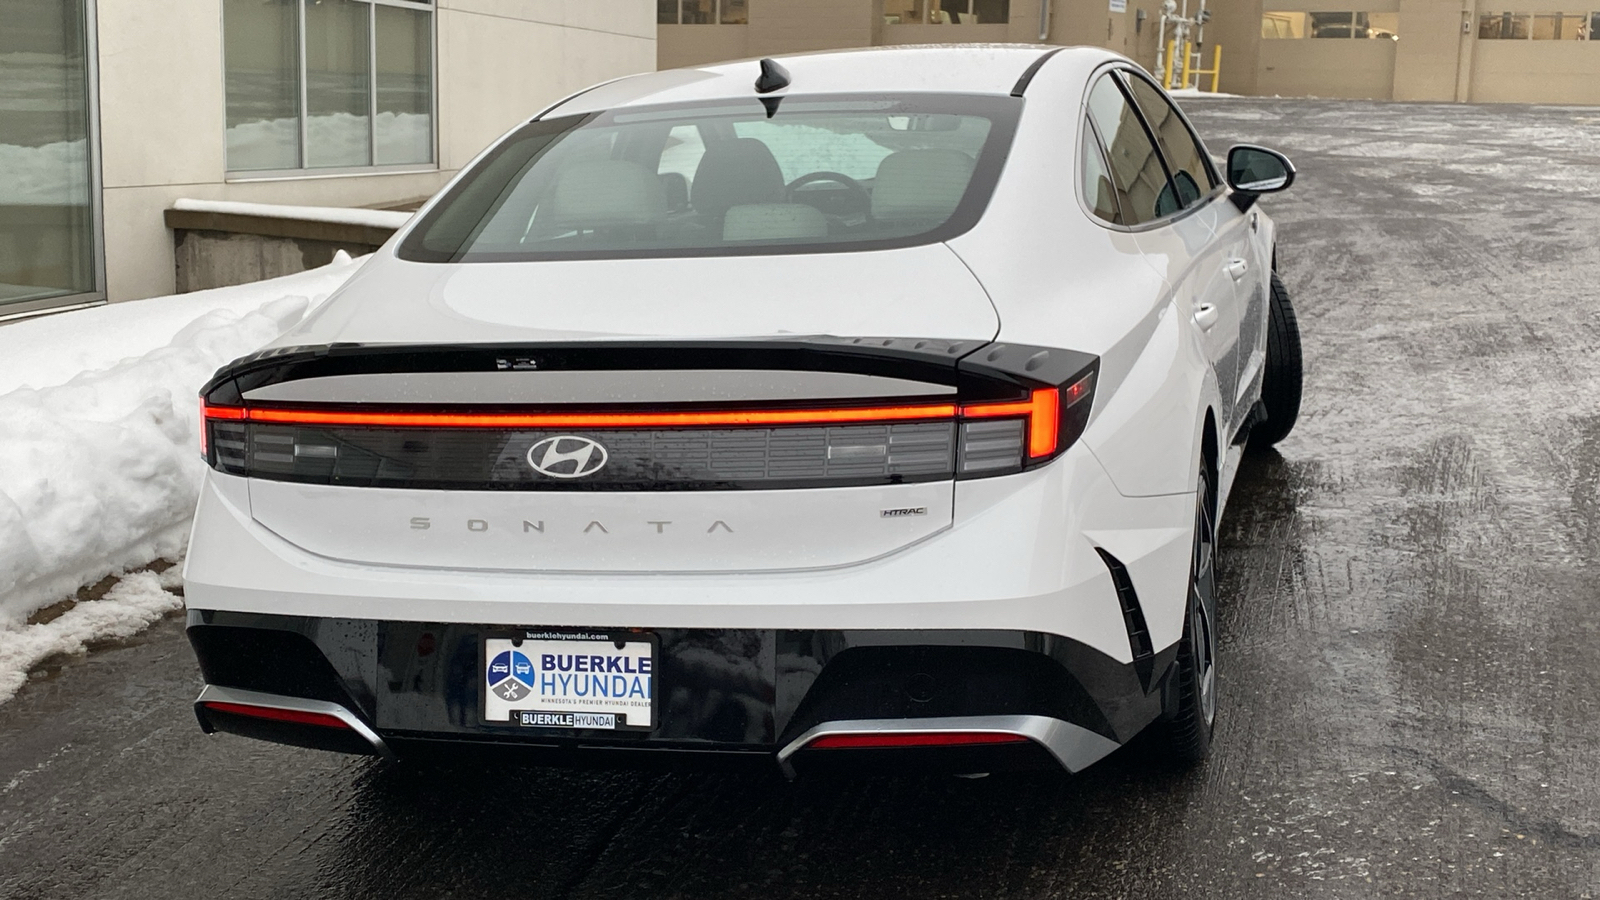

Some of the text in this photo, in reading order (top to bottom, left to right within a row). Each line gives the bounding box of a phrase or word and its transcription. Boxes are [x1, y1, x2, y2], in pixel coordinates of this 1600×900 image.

[883, 507, 924, 516] HTRAC
[410, 517, 734, 534] SONATA
[526, 632, 609, 640] buerklehyundai.com
[541, 654, 652, 674] BUERKLE
[541, 673, 652, 699] HYUNDAI
[522, 713, 614, 727] BUERKLE HYUNDAI
